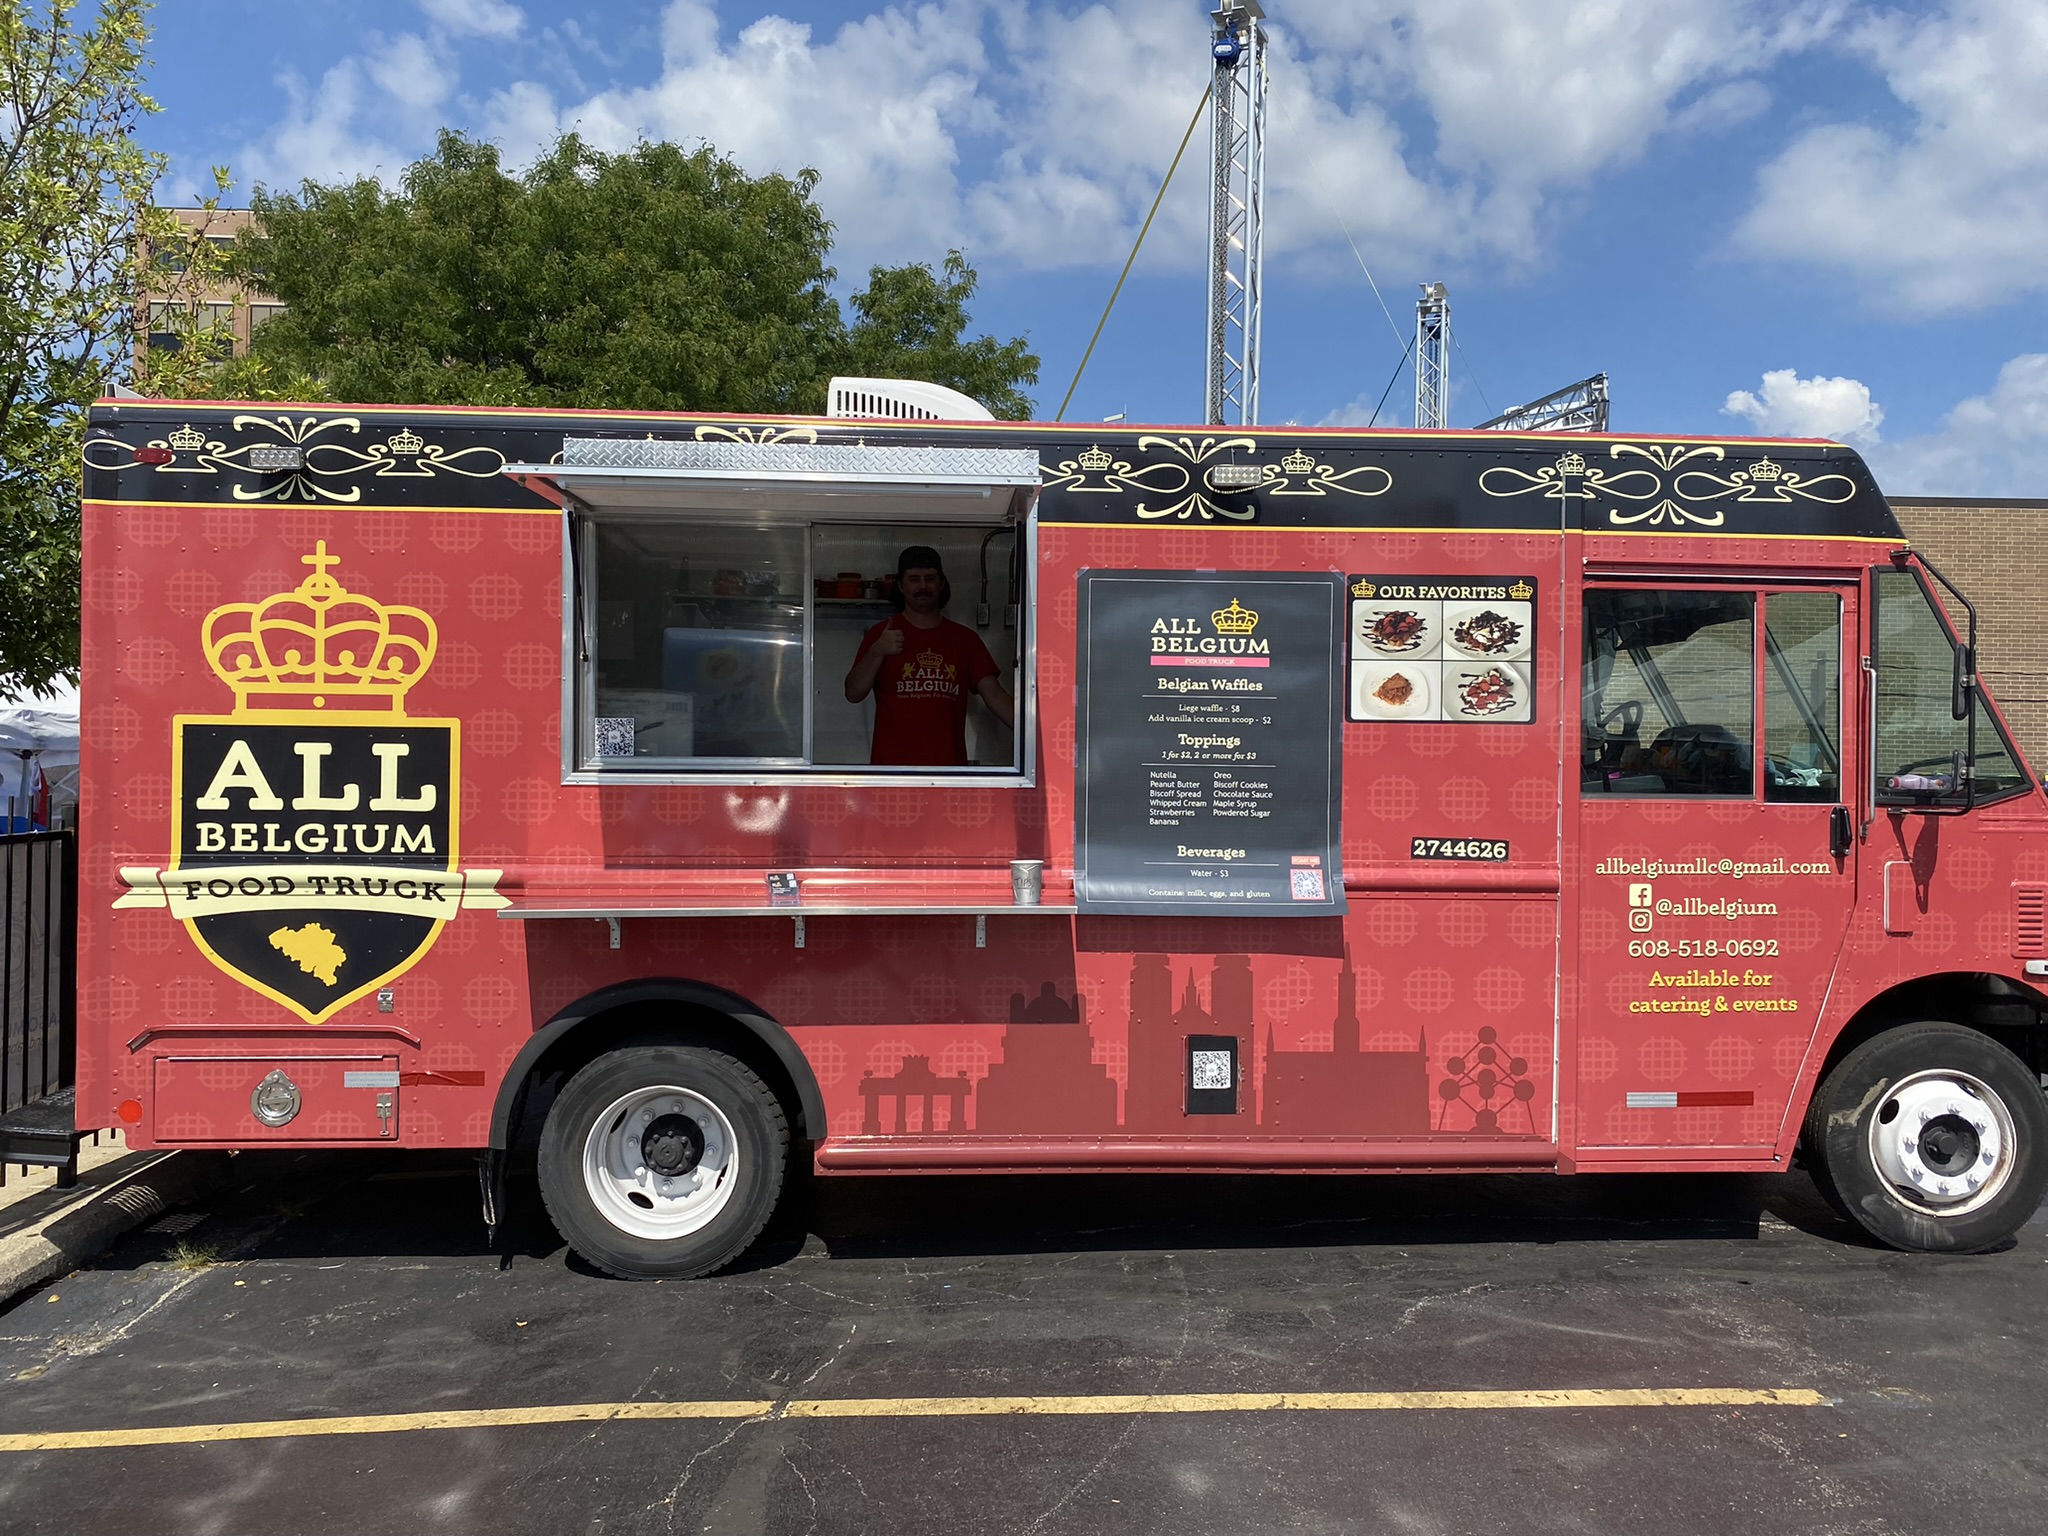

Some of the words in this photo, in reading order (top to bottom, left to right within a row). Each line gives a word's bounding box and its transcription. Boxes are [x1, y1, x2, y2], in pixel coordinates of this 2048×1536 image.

[1380, 585, 1416, 598] OUR
[1418, 586, 1506, 599] FAVORITES
[1150, 617, 1201, 634] ALL
[1150, 637, 1271, 654] BELGIUM
[915, 668, 944, 679] ALL
[896, 680, 959, 695] BELGIUM
[1157, 677, 1209, 693] Belgian
[1211, 679, 1263, 691] Waffles
[1179, 704, 1199, 713] Liege
[1200, 704, 1224, 712] waffle
[1231, 705, 1240, 713] $8
[1148, 714, 1164, 723] Add
[1165, 715, 1192, 723] vanilla
[1193, 715, 1205, 723] ice
[1231, 717, 1254, 725] scoop
[1262, 716, 1271, 725] $2
[1178, 733, 1241, 748] Toppings
[1162, 751, 1166, 759] 1
[1166, 751, 1179, 761] for
[1180, 751, 1193, 760] $2,
[1194, 751, 1200, 759] 2
[1233, 751, 1246, 761] for
[1246, 751, 1256, 761] $3
[196, 739, 437, 812] ALL
[1150, 771, 1177, 779] Nutella
[1150, 781, 1176, 789] Peanut
[1177, 781, 1201, 789] Butter
[1213, 781, 1239, 789] Biscoff
[1240, 781, 1268, 789] Cookies
[1150, 790, 1175, 798] Biscoff
[1177, 790, 1202, 798] Spread
[1213, 790, 1249, 798] Chocolate
[1251, 791, 1273, 799] Sauce
[1150, 799, 1181, 808] Whipped
[1213, 800, 1235, 808] Maple
[1236, 800, 1257, 809] Syrup
[1213, 809, 1249, 817] Powdered
[1250, 809, 1271, 818] Sugar
[196, 822, 436, 854] BELGIUM
[1177, 845, 1246, 860] Beverages
[1413, 839, 1507, 859] 2744626
[1190, 869, 1213, 878] Water
[1220, 869, 1229, 878] $3
[1596, 858, 1830, 878] allbelgiumllc@gmail.com
[182, 876, 297, 901] FOOD
[308, 876, 446, 901] TRUCK
[1148, 888, 1184, 898] Contains:
[1187, 889, 1208, 899] milk,
[1209, 891, 1228, 900] eggs,
[1229, 889, 1245, 898] and
[1246, 890, 1271, 900] gluten
[1655, 897, 1778, 920] @allbelgium
[1628, 939, 1779, 957] 608-518-0692
[1649, 969, 1739, 988] Available
[1743, 970, 1772, 987] for
[1629, 996, 1711, 1016] catering
[1713, 997, 1729, 1012] &
[1733, 998, 1798, 1013] events
